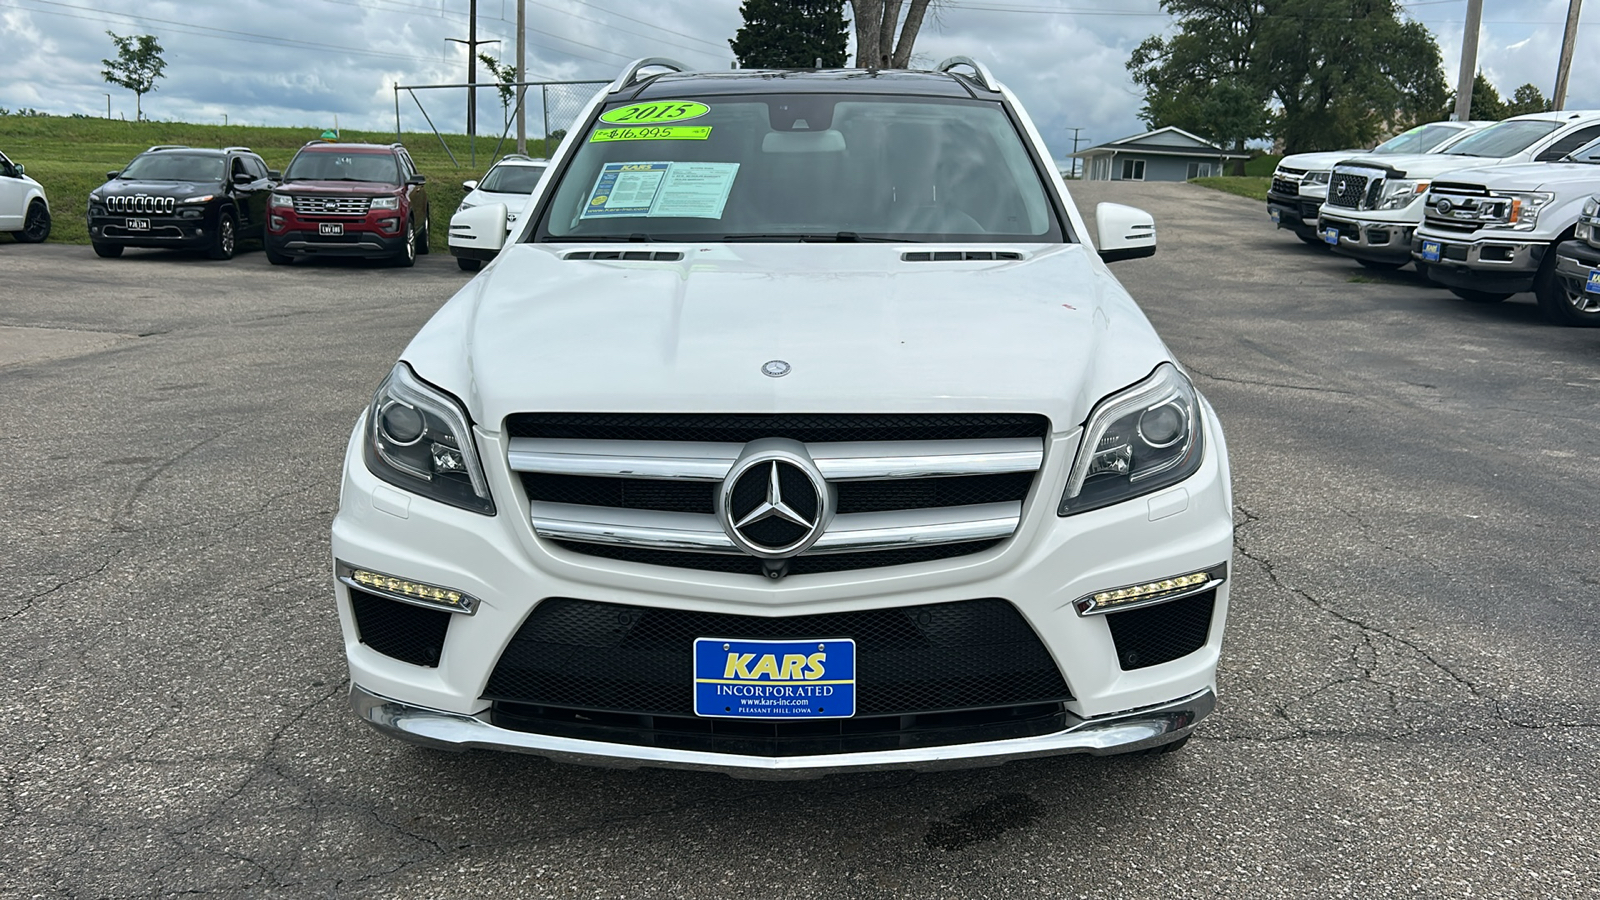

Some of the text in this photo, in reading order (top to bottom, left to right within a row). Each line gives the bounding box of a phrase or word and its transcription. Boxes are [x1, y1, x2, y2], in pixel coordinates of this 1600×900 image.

[615, 104, 693, 121] 2015
[723, 652, 827, 680] KARS
[716, 684, 834, 697] INCORPORATED
[740, 697, 809, 706] www.kars-inc.com
